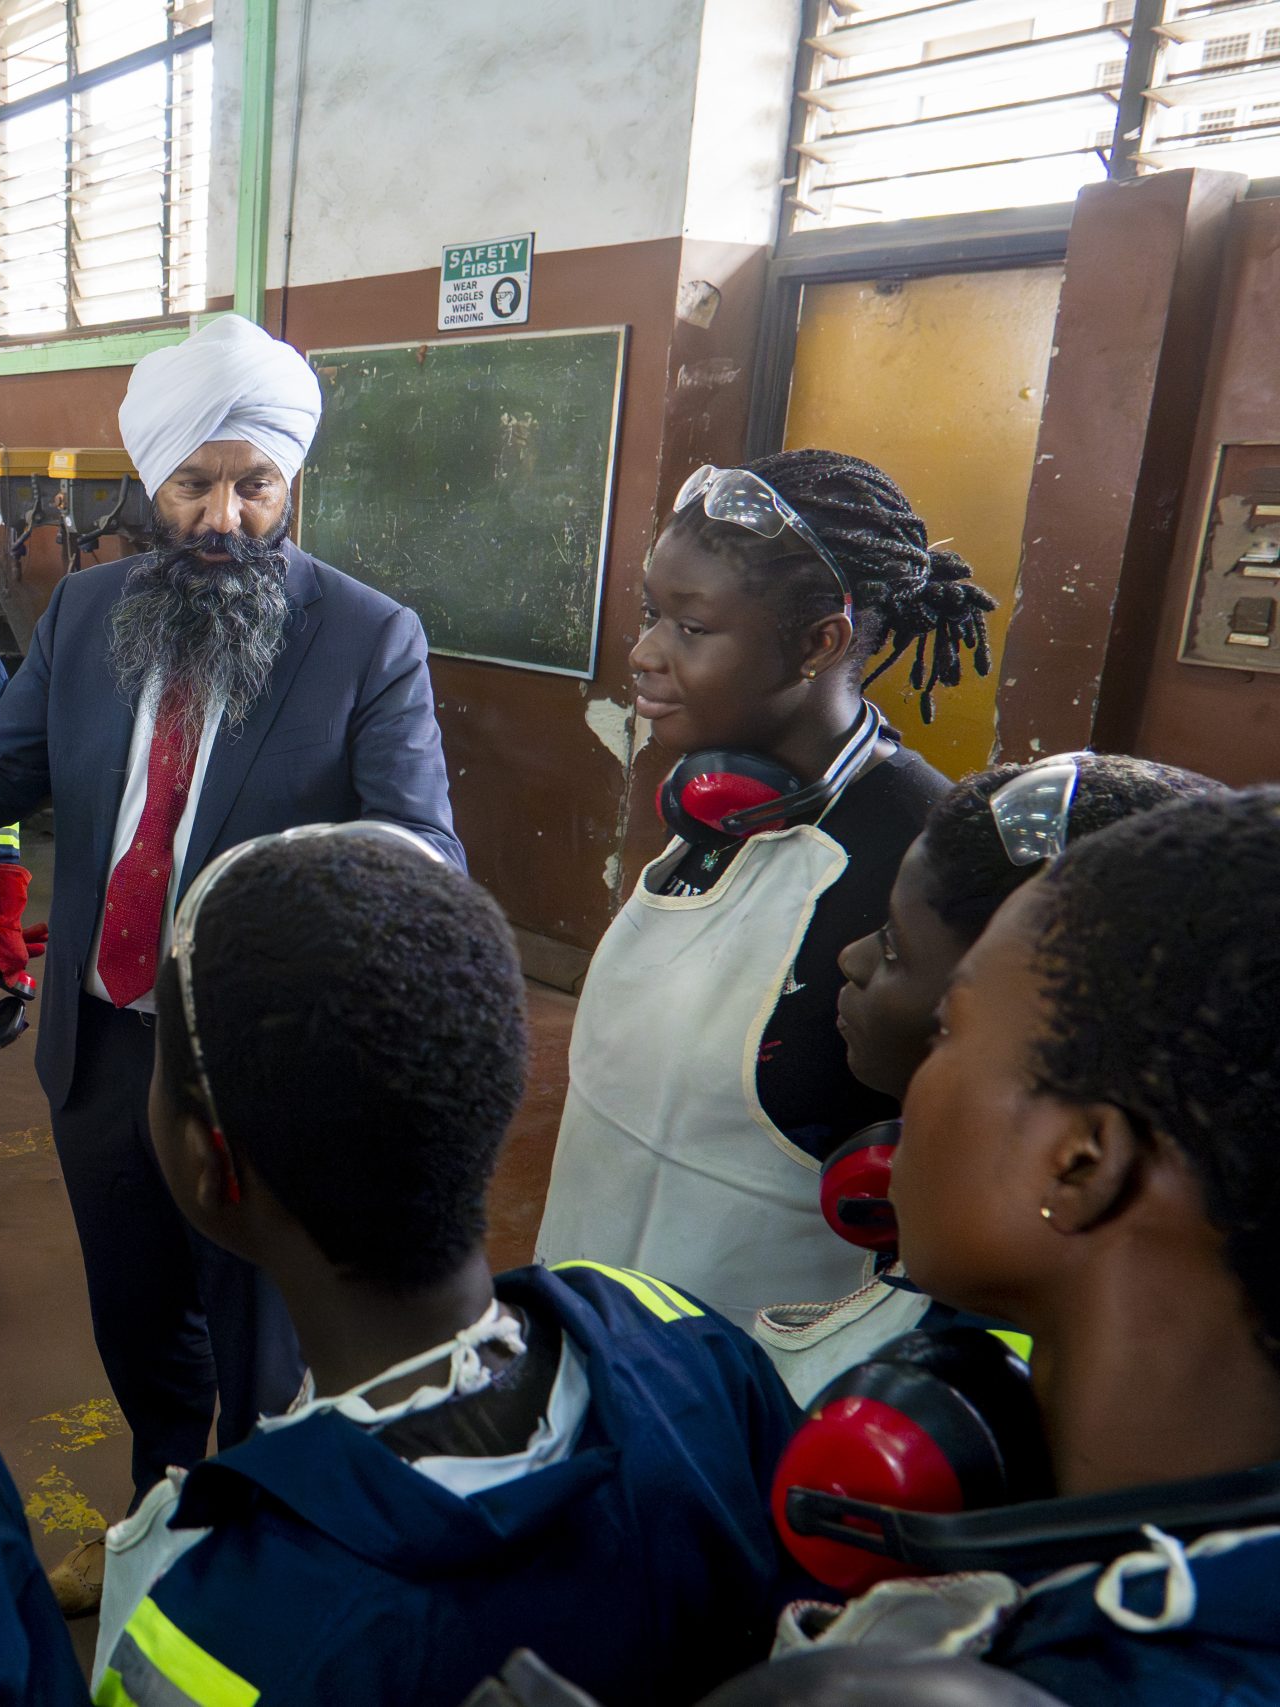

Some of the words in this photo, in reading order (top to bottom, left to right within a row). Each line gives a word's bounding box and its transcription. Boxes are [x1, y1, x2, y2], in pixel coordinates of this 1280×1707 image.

[449, 241, 523, 269] SAFETY
[461, 259, 508, 277] FIRST
[453, 281, 477, 292] WEAR
[446, 290, 484, 303] GOGGLES
[452, 302, 477, 313] WHEN
[444, 312, 484, 325] GRINDING
